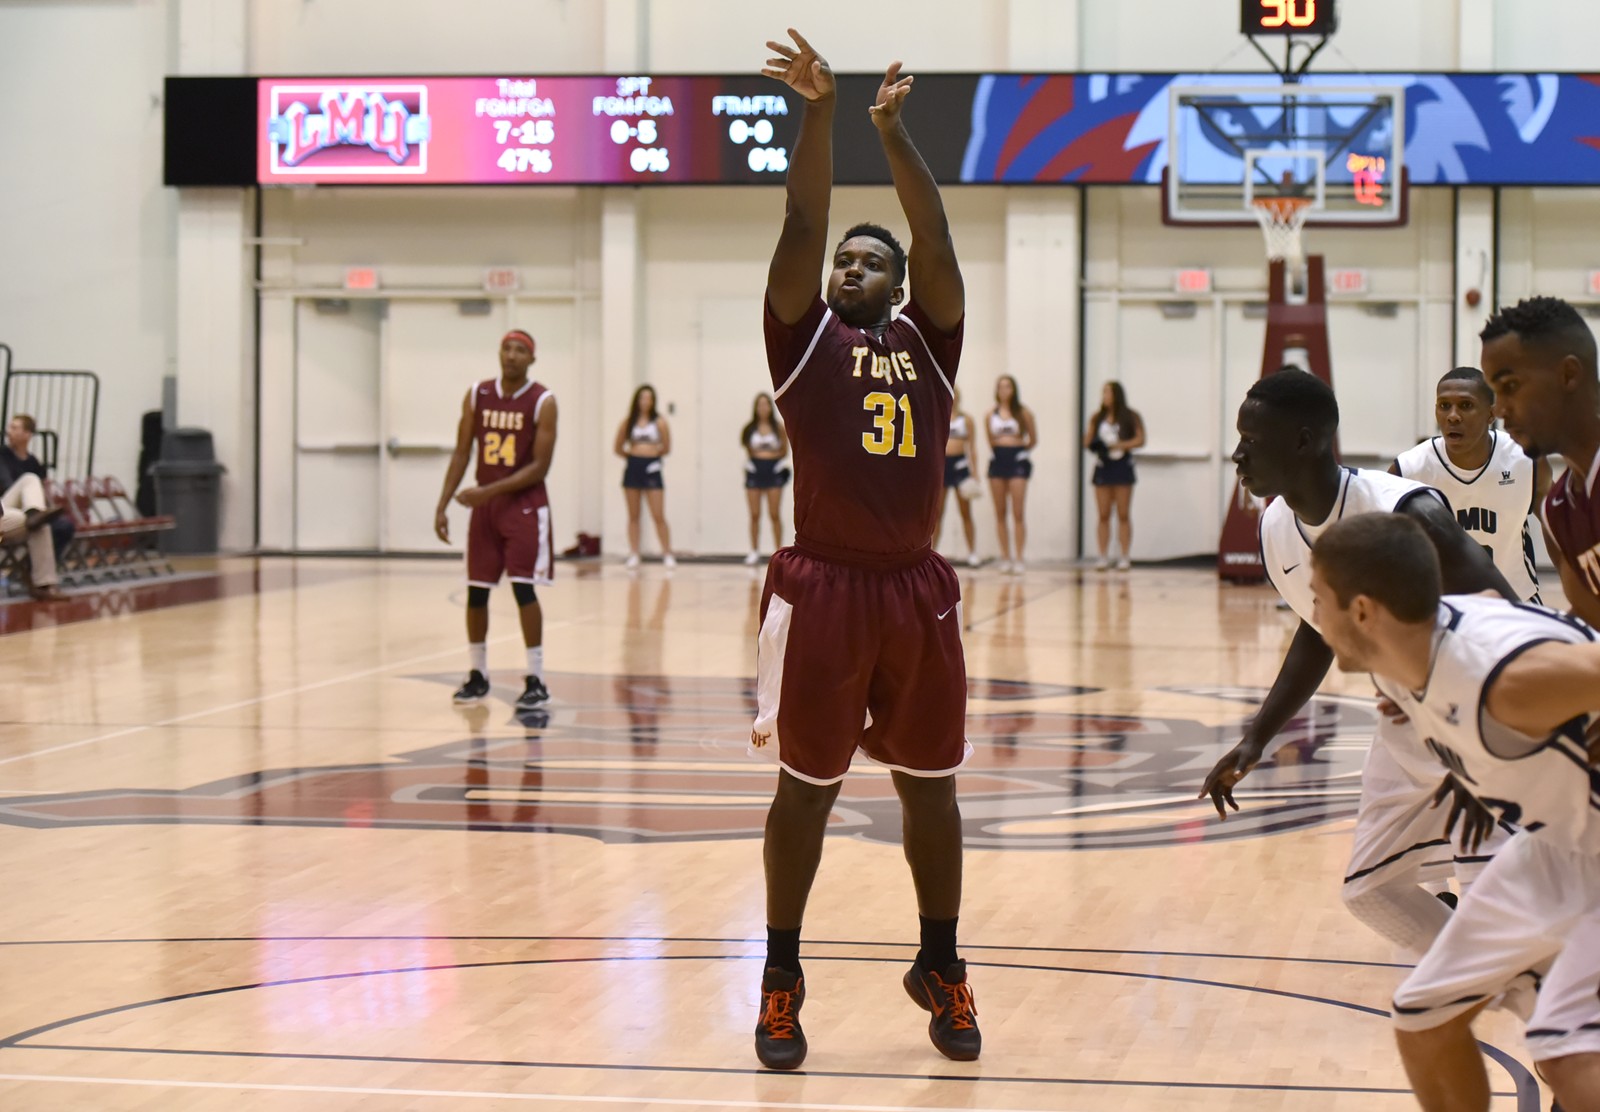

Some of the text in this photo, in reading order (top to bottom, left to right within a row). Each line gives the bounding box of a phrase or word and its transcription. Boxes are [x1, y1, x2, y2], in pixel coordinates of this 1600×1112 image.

[282, 88, 411, 167] LMU
[493, 120, 555, 144] 7-15
[610, 120, 658, 144] 0-5
[729, 119, 774, 144] 0-0
[497, 148, 553, 173] 47%
[630, 148, 670, 172] 0%
[748, 147, 788, 172] 0%
[862, 391, 917, 458] 31
[484, 432, 516, 467] 24
[1456, 507, 1497, 534] MU
